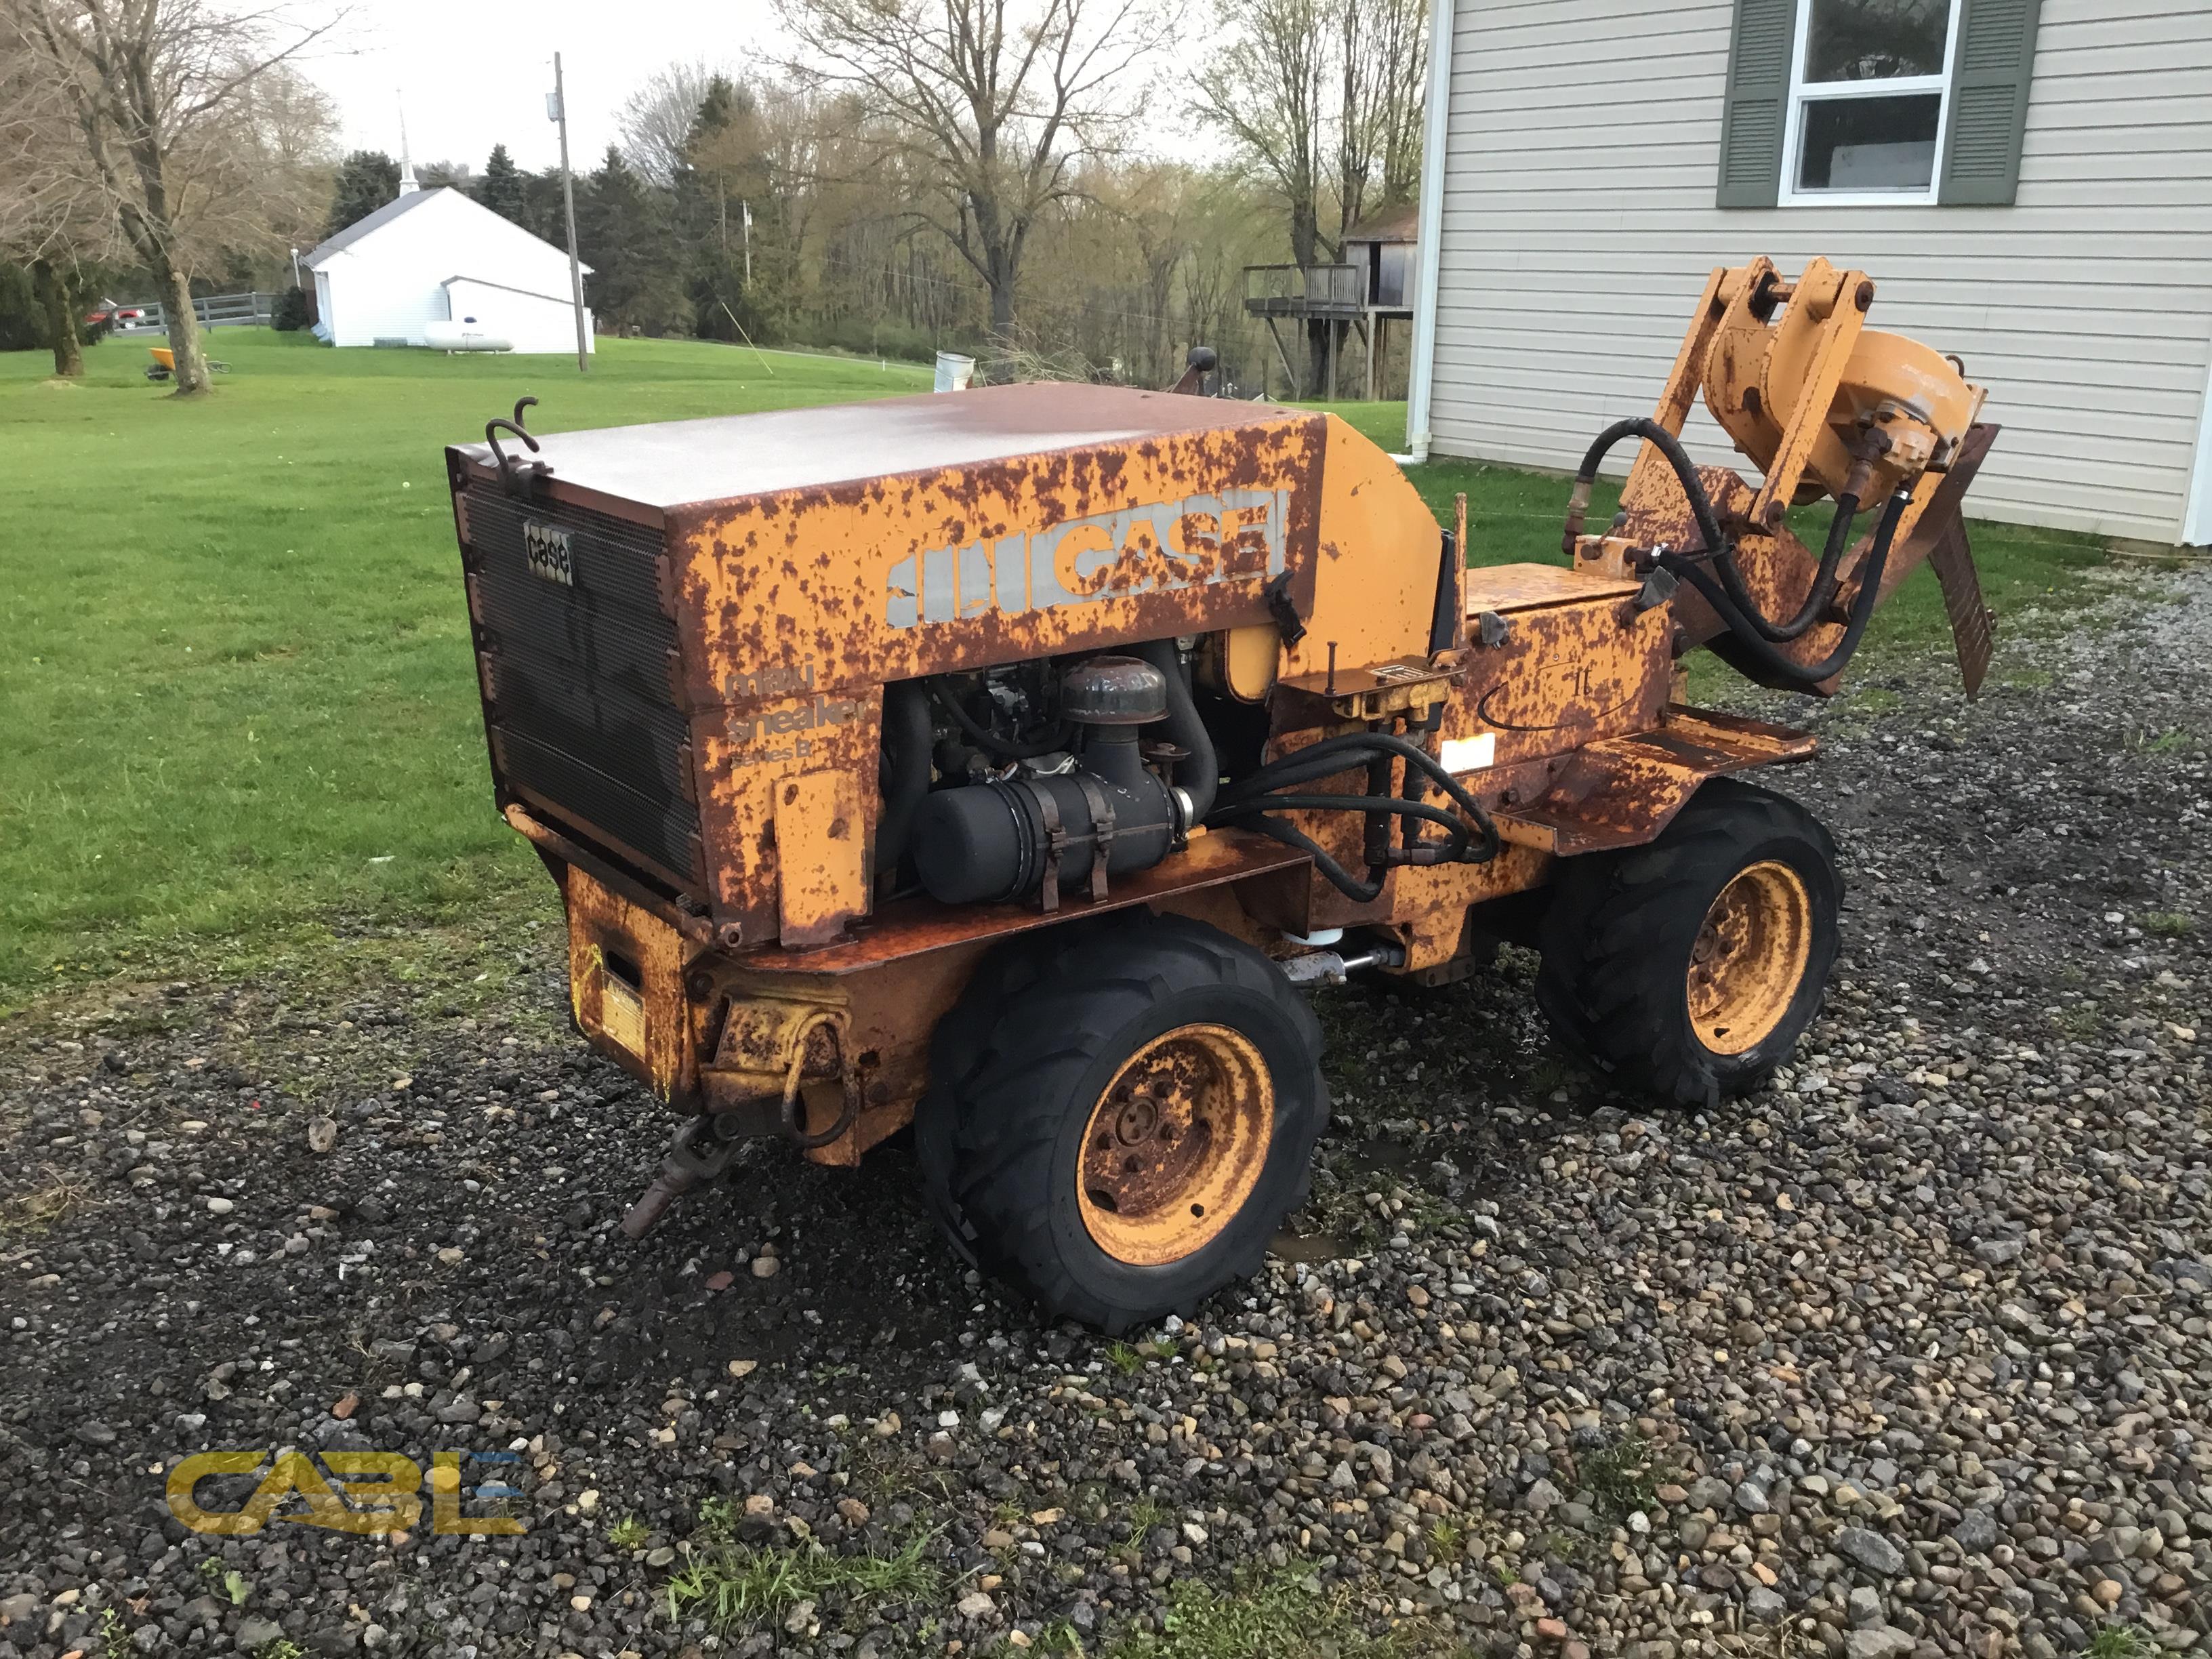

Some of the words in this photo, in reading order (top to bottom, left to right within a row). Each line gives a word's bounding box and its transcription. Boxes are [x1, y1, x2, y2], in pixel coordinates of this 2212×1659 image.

[1054, 505, 1270, 596] CASE
[724, 653, 815, 699] maxi
[728, 695, 871, 742] sneaker
